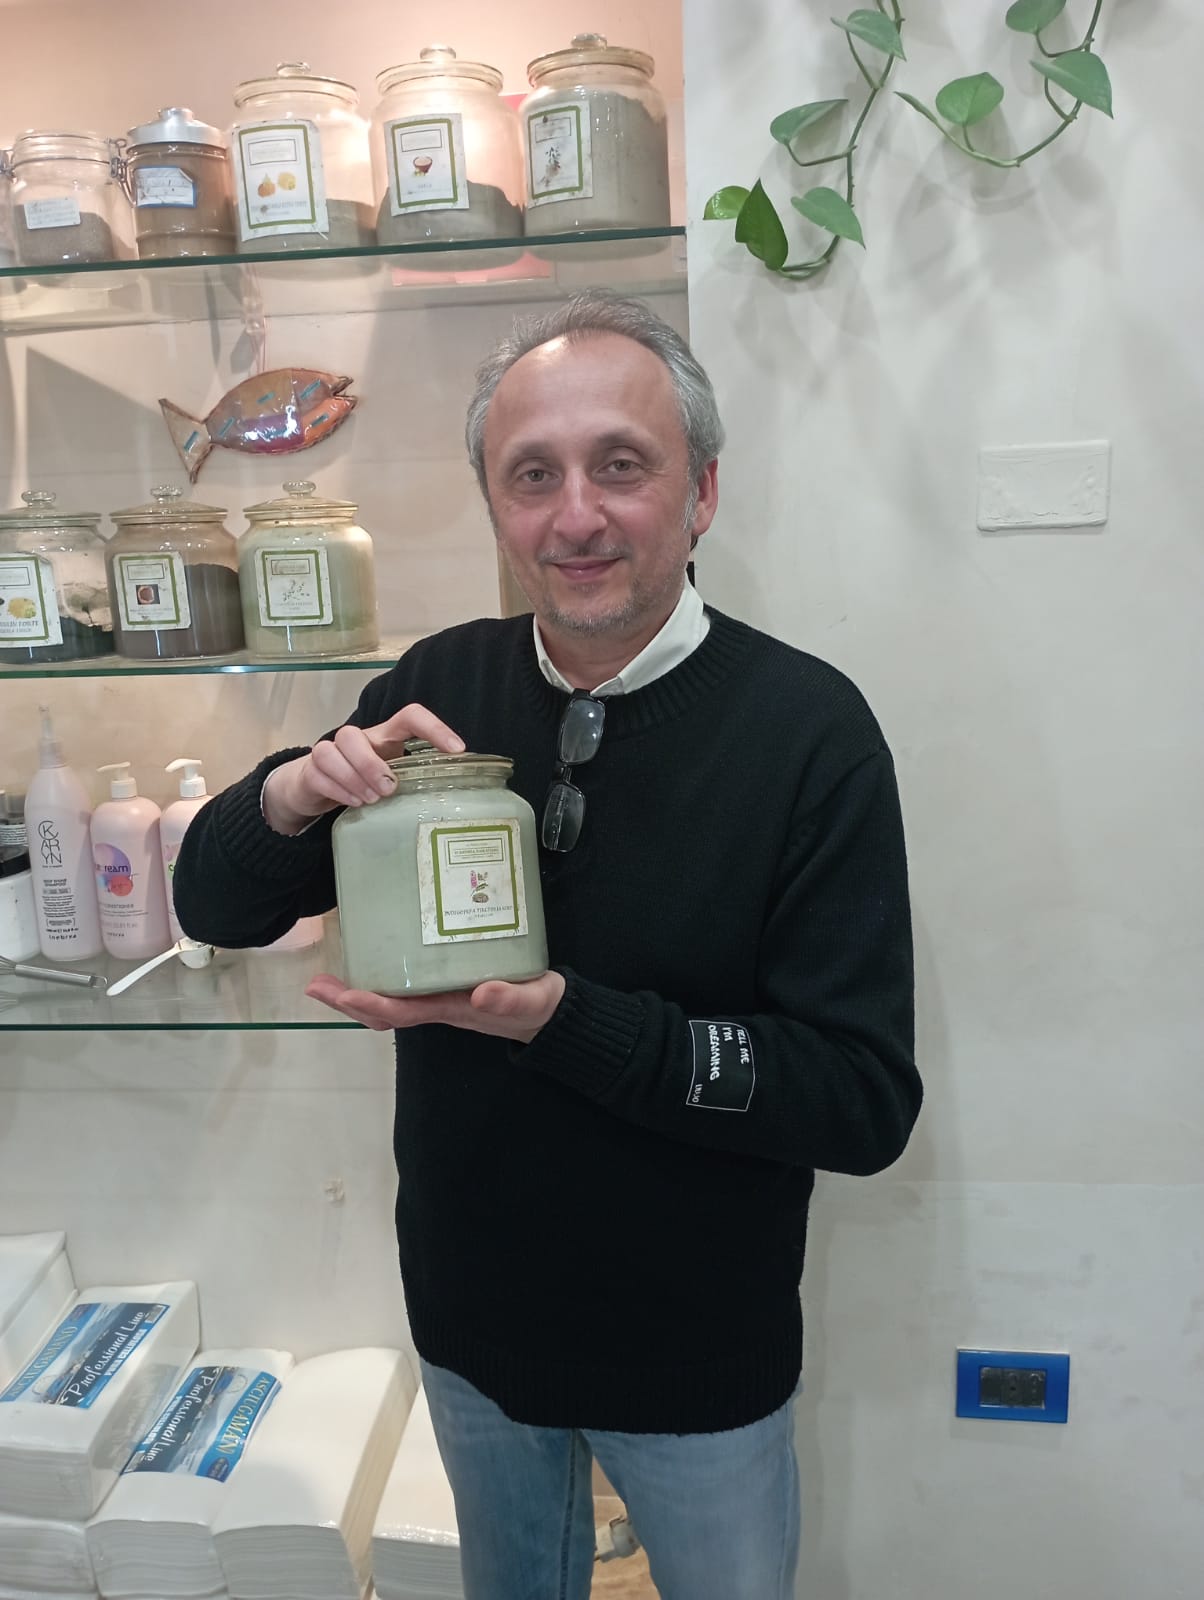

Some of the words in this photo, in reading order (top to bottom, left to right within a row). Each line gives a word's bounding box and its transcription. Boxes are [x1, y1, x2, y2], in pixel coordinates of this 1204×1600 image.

[708, 1024, 721, 1081] DREAMING
[736, 1029, 748, 1045] TELL
[740, 1047, 750, 1065] ME
[68, 1331, 129, 1397] Professional
[121, 1311, 145, 1332] Line
[161, 1375, 215, 1444] Professional
[147, 1441, 170, 1462] Line
